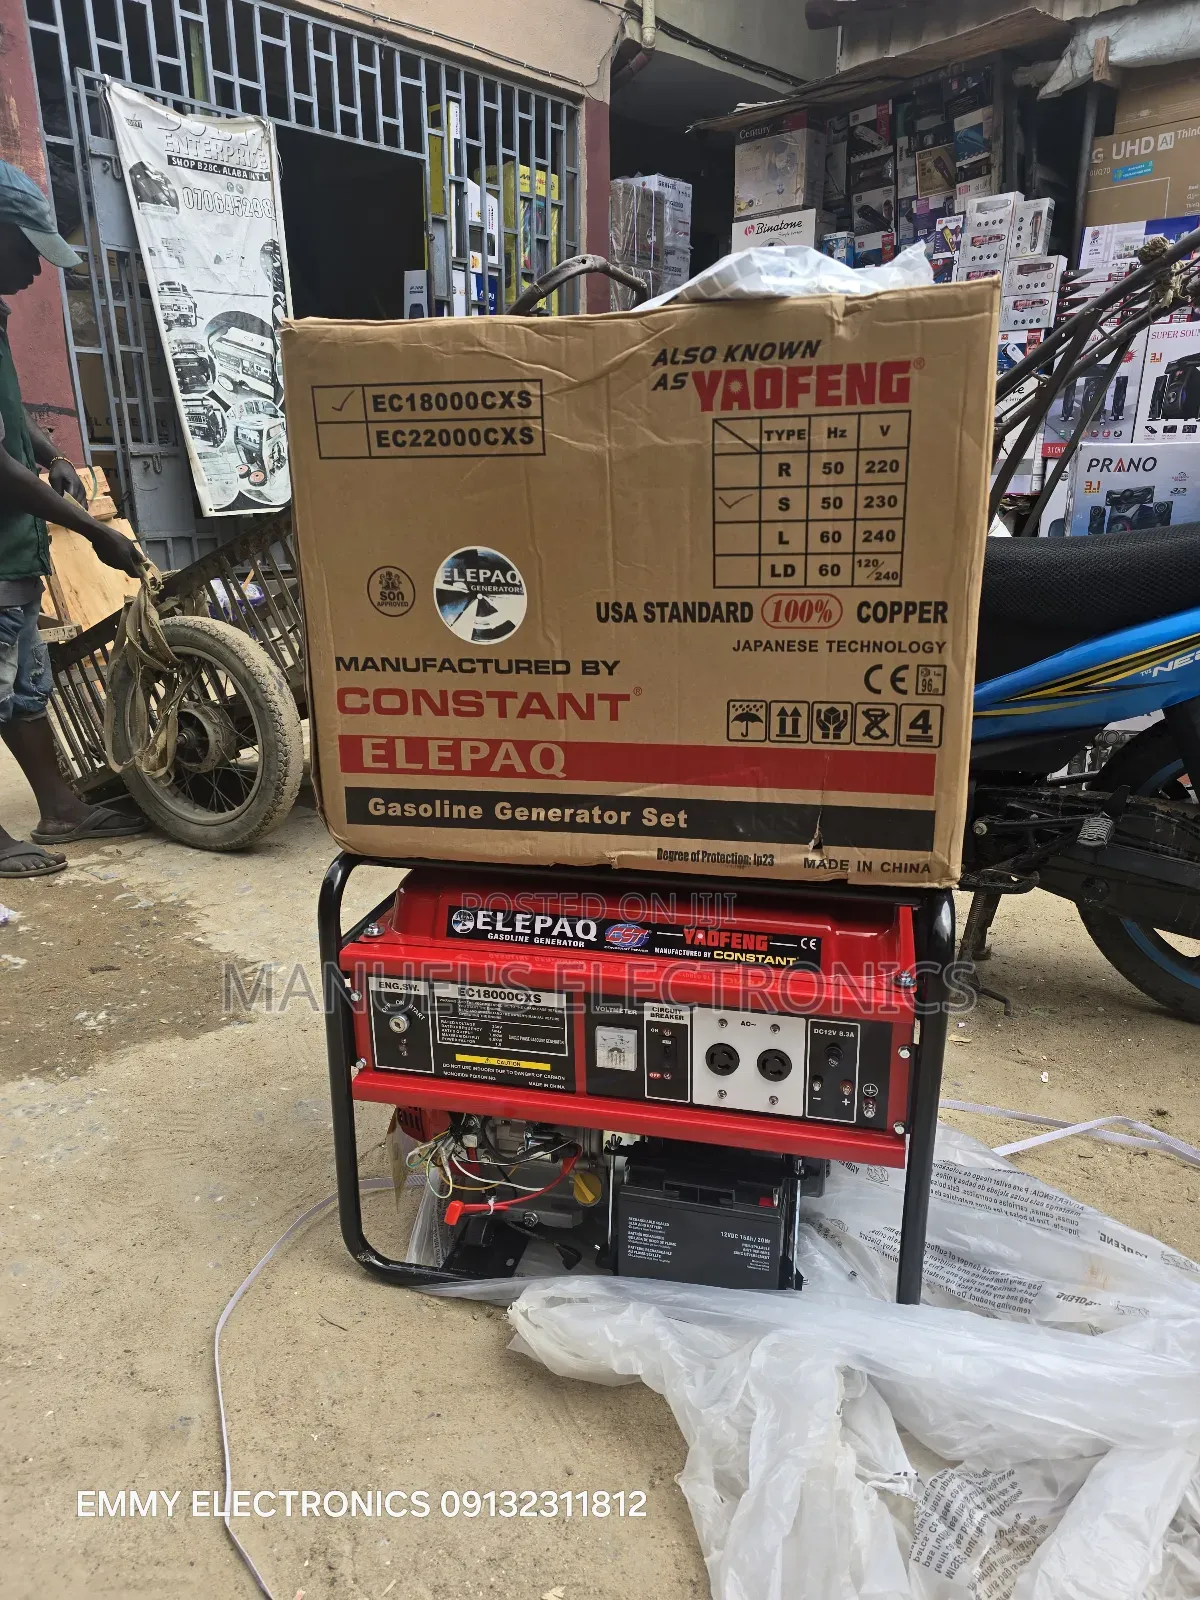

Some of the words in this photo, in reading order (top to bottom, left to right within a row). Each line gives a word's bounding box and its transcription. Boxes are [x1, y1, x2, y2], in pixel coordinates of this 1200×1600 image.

[739, 126, 771, 139] Century
[1091, 148, 1104, 163] G
[1112, 136, 1154, 160] UHD
[1159, 135, 1173, 147] AI
[172, 156, 195, 169] SHOP
[222, 166, 248, 179] ALABA
[755, 220, 803, 234] Binatone
[1151, 330, 1179, 340] SUPER
[652, 346, 717, 367] ALSO
[722, 339, 822, 363] KNOWN
[652, 371, 689, 391] AS
[372, 389, 533, 413] EC18000CXS
[375, 426, 535, 449] EC22000CXS
[764, 428, 806, 442] TYPE
[826, 426, 847, 438] Hz
[879, 425, 890, 437] V
[778, 462, 792, 477] R
[821, 461, 845, 475] 50
[865, 459, 900, 473] 220
[1087, 457, 1157, 472] PRANO
[779, 497, 790, 512] S
[820, 496, 843, 510] 50
[863, 495, 898, 508] 230
[778, 531, 789, 545] L
[819, 530, 842, 543] 60
[862, 529, 896, 542] 240
[441, 568, 522, 585] ELEPAQ
[770, 563, 796, 578] LD
[818, 563, 841, 577] 60
[376, 600, 409, 608] APPROVED
[596, 601, 638, 623] USA
[643, 601, 754, 623] STANDARD
[770, 598, 833, 623] 100%
[857, 601, 948, 624] COPPER
[732, 640, 819, 653] JAPANESE
[826, 640, 946, 654] TECHNOLOGY
[335, 656, 571, 675] MANUFACTURED
[581, 660, 620, 676] BY
[863, 664, 909, 694] CE
[336, 687, 630, 721] CONSTANT
[361, 737, 567, 778] ELEPAQ
[368, 797, 483, 819] Gasoline
[494, 801, 631, 825] Generator
[642, 807, 688, 828] Set
[657, 847, 689, 863] Degree
[690, 849, 700, 862] of
[701, 850, 751, 866] Protection:
[803, 857, 849, 871] MADE
[857, 860, 873, 873] IN
[880, 861, 931, 874] CHINA
[477, 910, 597, 941] ELEPAQ
[487, 932, 530, 943] GASOLINE
[534, 937, 585, 948] GENERATOR
[800, 937, 817, 950] CE
[654, 947, 701, 957] MANUFACTURED
[713, 951, 796, 966] CONSTANT
[378, 981, 420, 992] ENG.SW.
[458, 987, 542, 1004] EC18000CXS
[381, 1002, 391, 1013] OFF
[408, 1003, 426, 1021] START
[595, 1005, 638, 1015] VOLTMETER
[652, 1006, 682, 1015] CIRCUIT
[650, 1013, 684, 1021] BREAKER
[839, 1030, 855, 1038] 8.3A
[496, 1059, 521, 1067] CAUTION
[720, 1231, 739, 1239] 12VDC
